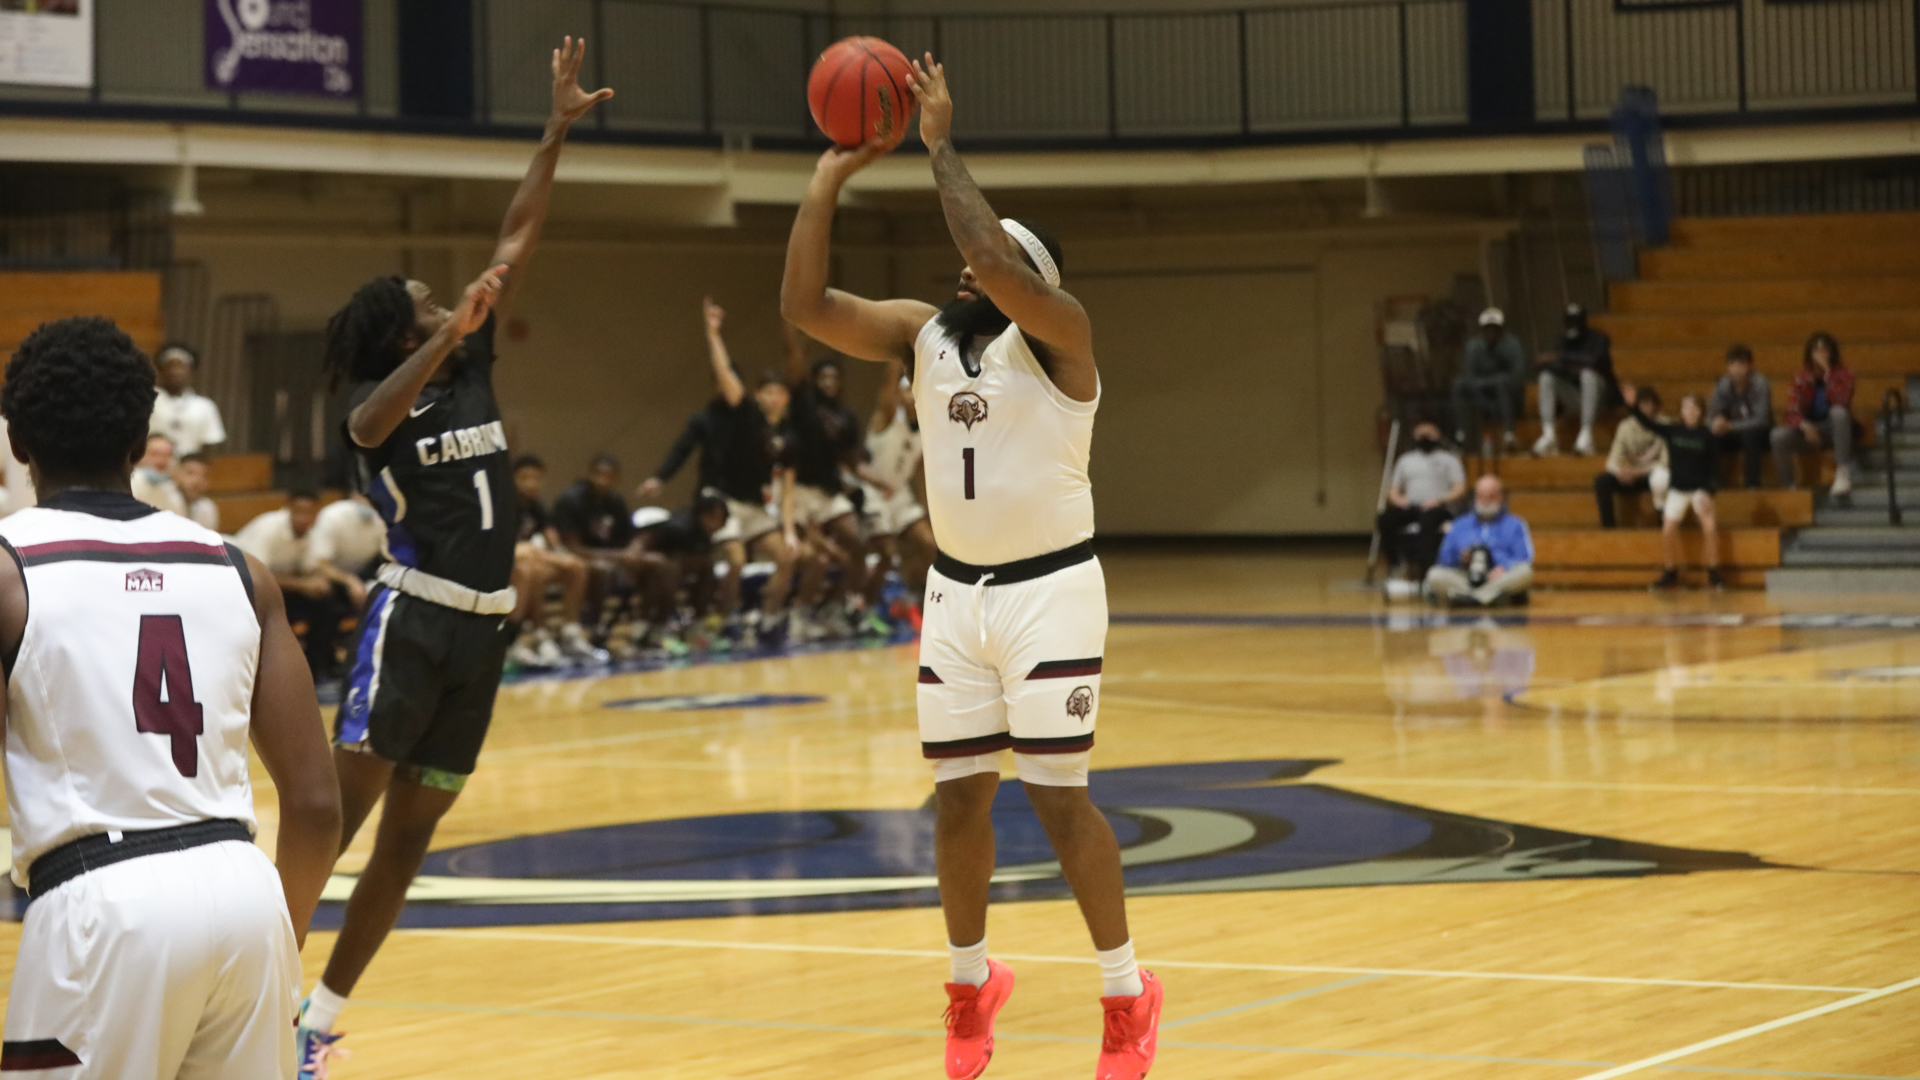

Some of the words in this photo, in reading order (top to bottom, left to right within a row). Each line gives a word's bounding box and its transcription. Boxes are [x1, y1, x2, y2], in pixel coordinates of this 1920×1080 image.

[415, 420, 508, 466] CABRIN
[473, 469, 494, 530] 1
[962, 447, 975, 500] 1
[127, 577, 162, 591] MAC
[132, 614, 204, 778] 4
